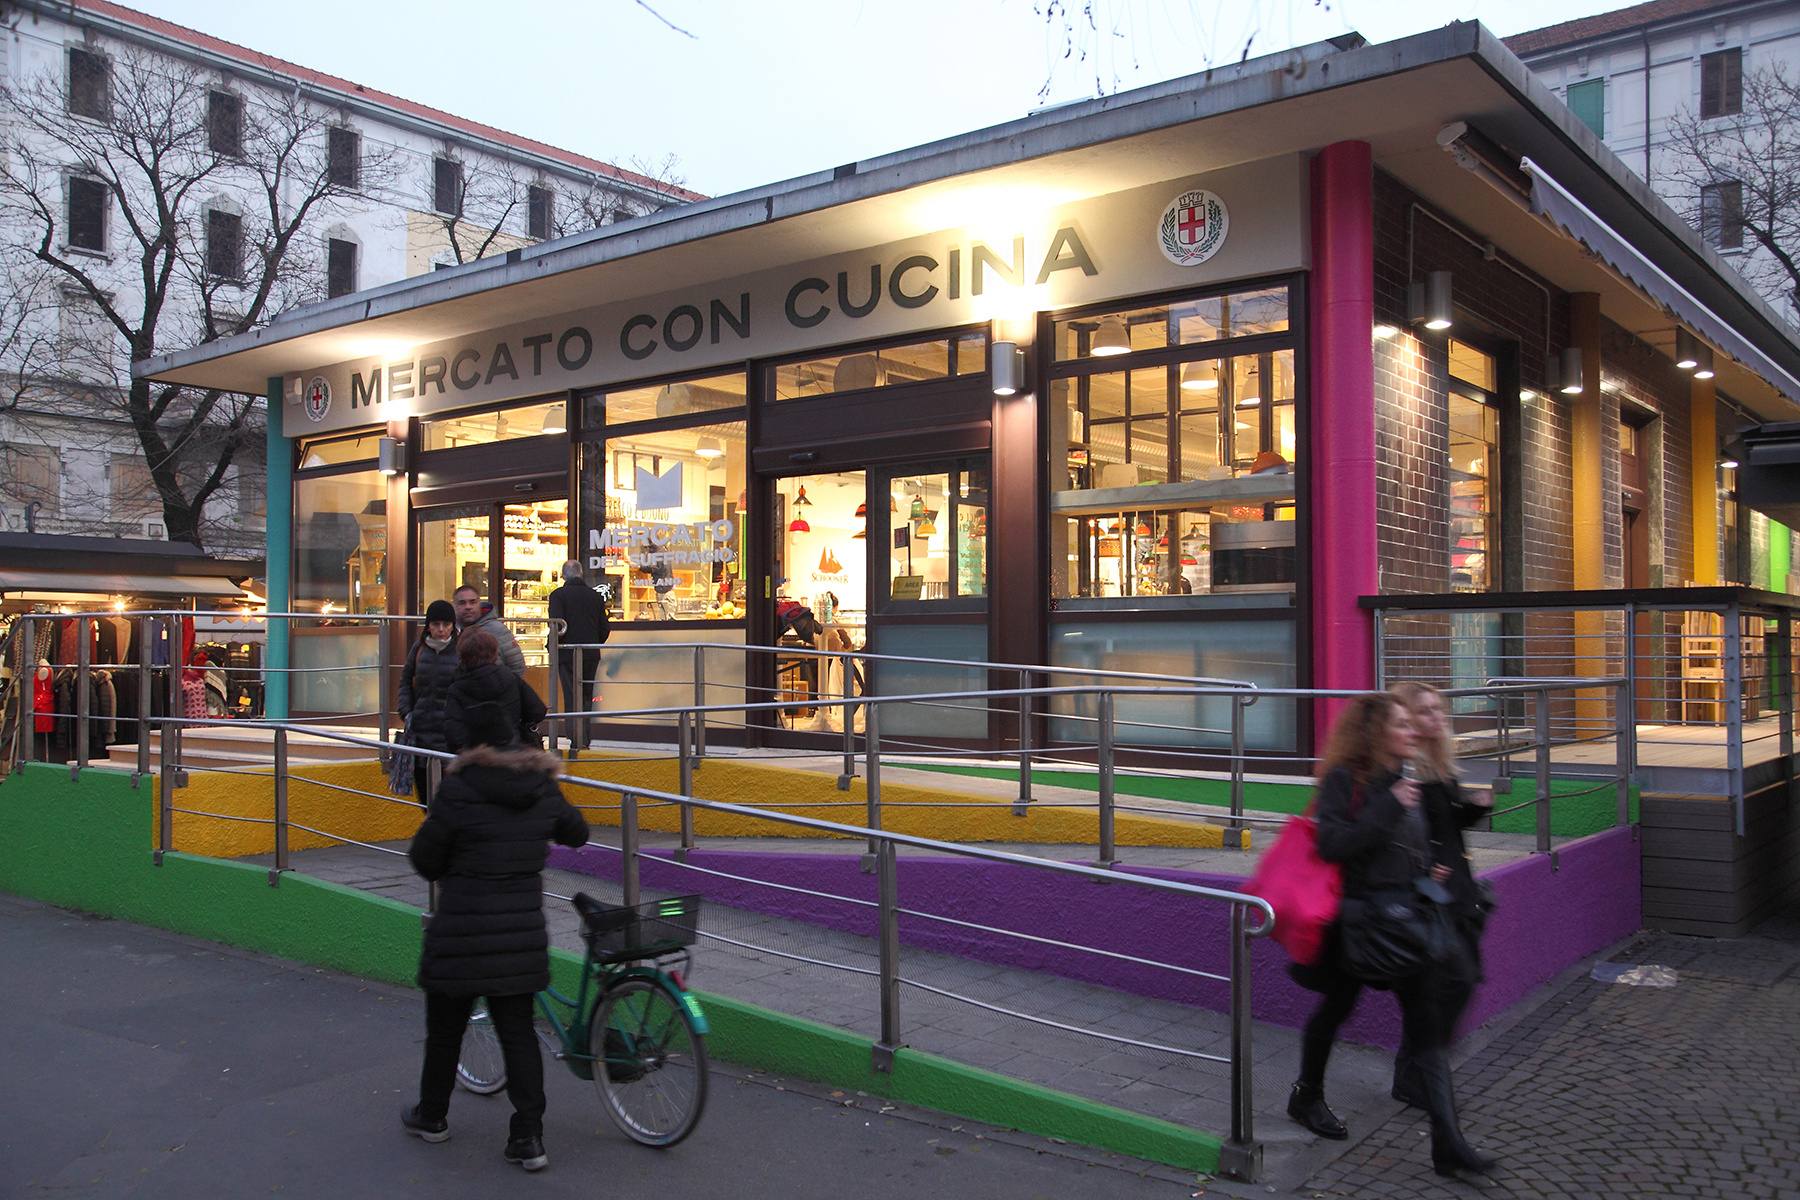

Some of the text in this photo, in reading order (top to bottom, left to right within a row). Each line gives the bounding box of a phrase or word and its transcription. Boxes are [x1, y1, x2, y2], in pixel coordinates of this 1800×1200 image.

[351, 226, 1098, 410] MERCATO CON CUCINA
[589, 518, 734, 550] MERCATO
[589, 547, 734, 570] DEL SUFFRAGIO
[634, 577, 682, 587] MILANO
[811, 572, 849, 584] SCHOONER
